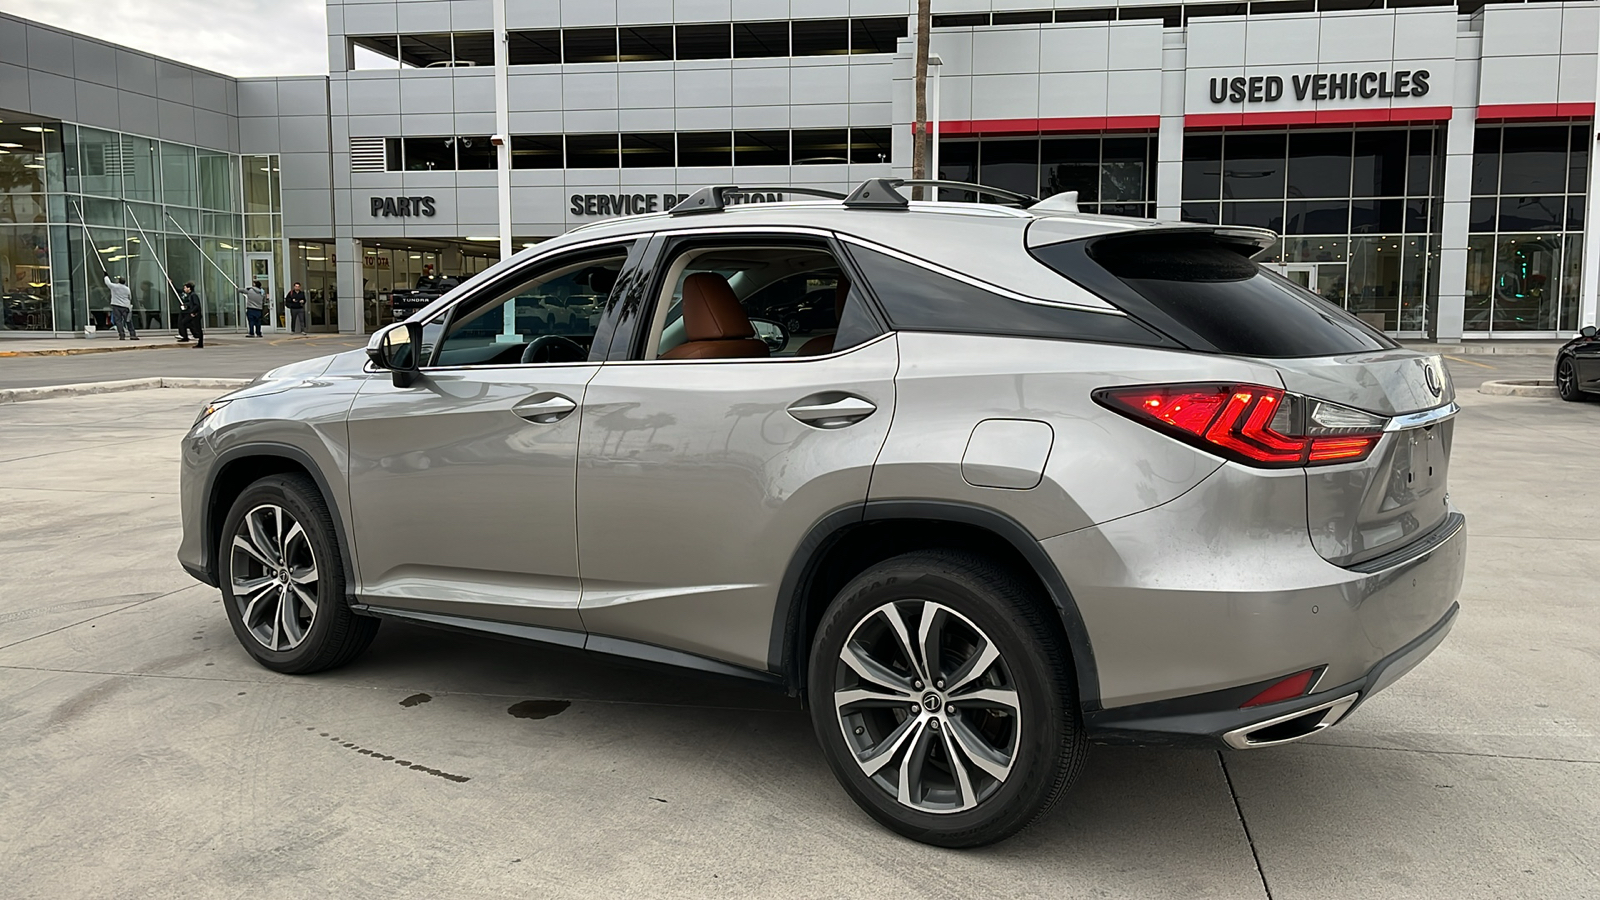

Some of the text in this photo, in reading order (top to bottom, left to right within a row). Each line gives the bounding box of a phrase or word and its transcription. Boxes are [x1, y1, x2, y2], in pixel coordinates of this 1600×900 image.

[1209, 70, 1430, 103] USED VEHICLES
[370, 196, 436, 217] PARTS
[570, 194, 658, 215] SERVICE
[364, 256, 389, 266] TOOTA
